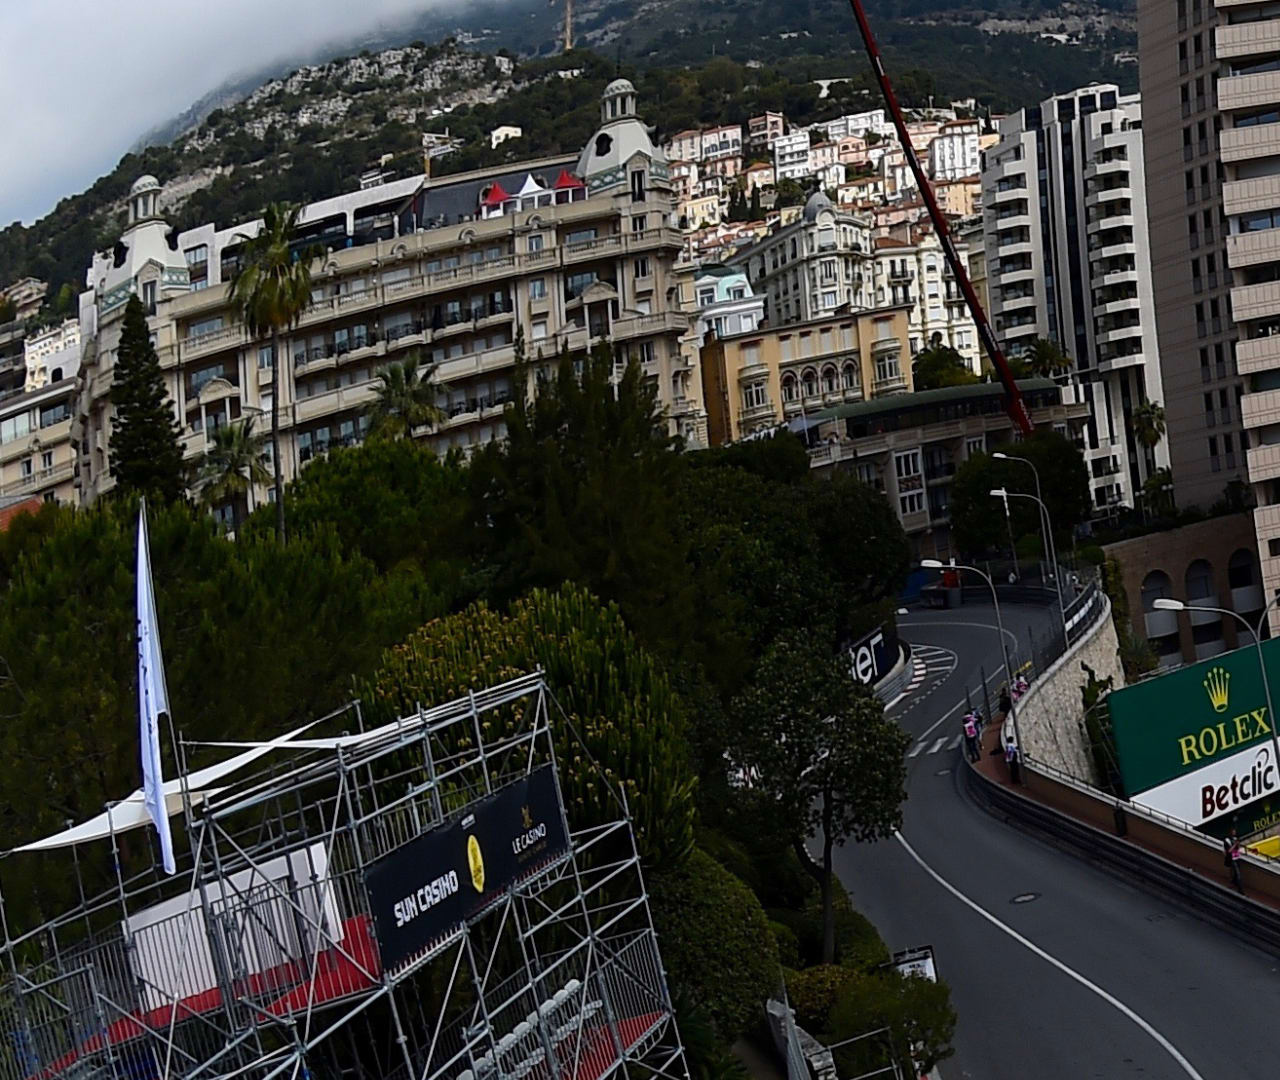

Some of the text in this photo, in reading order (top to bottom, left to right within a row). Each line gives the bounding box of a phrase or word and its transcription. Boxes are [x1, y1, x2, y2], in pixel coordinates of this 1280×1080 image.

[1178, 707, 1272, 765] ROLEX
[1201, 749, 1275, 819] Betclic
[511, 837, 522, 854] LE
[520, 822, 547, 849] CASINO
[394, 870, 459, 927] SUN CASINO
